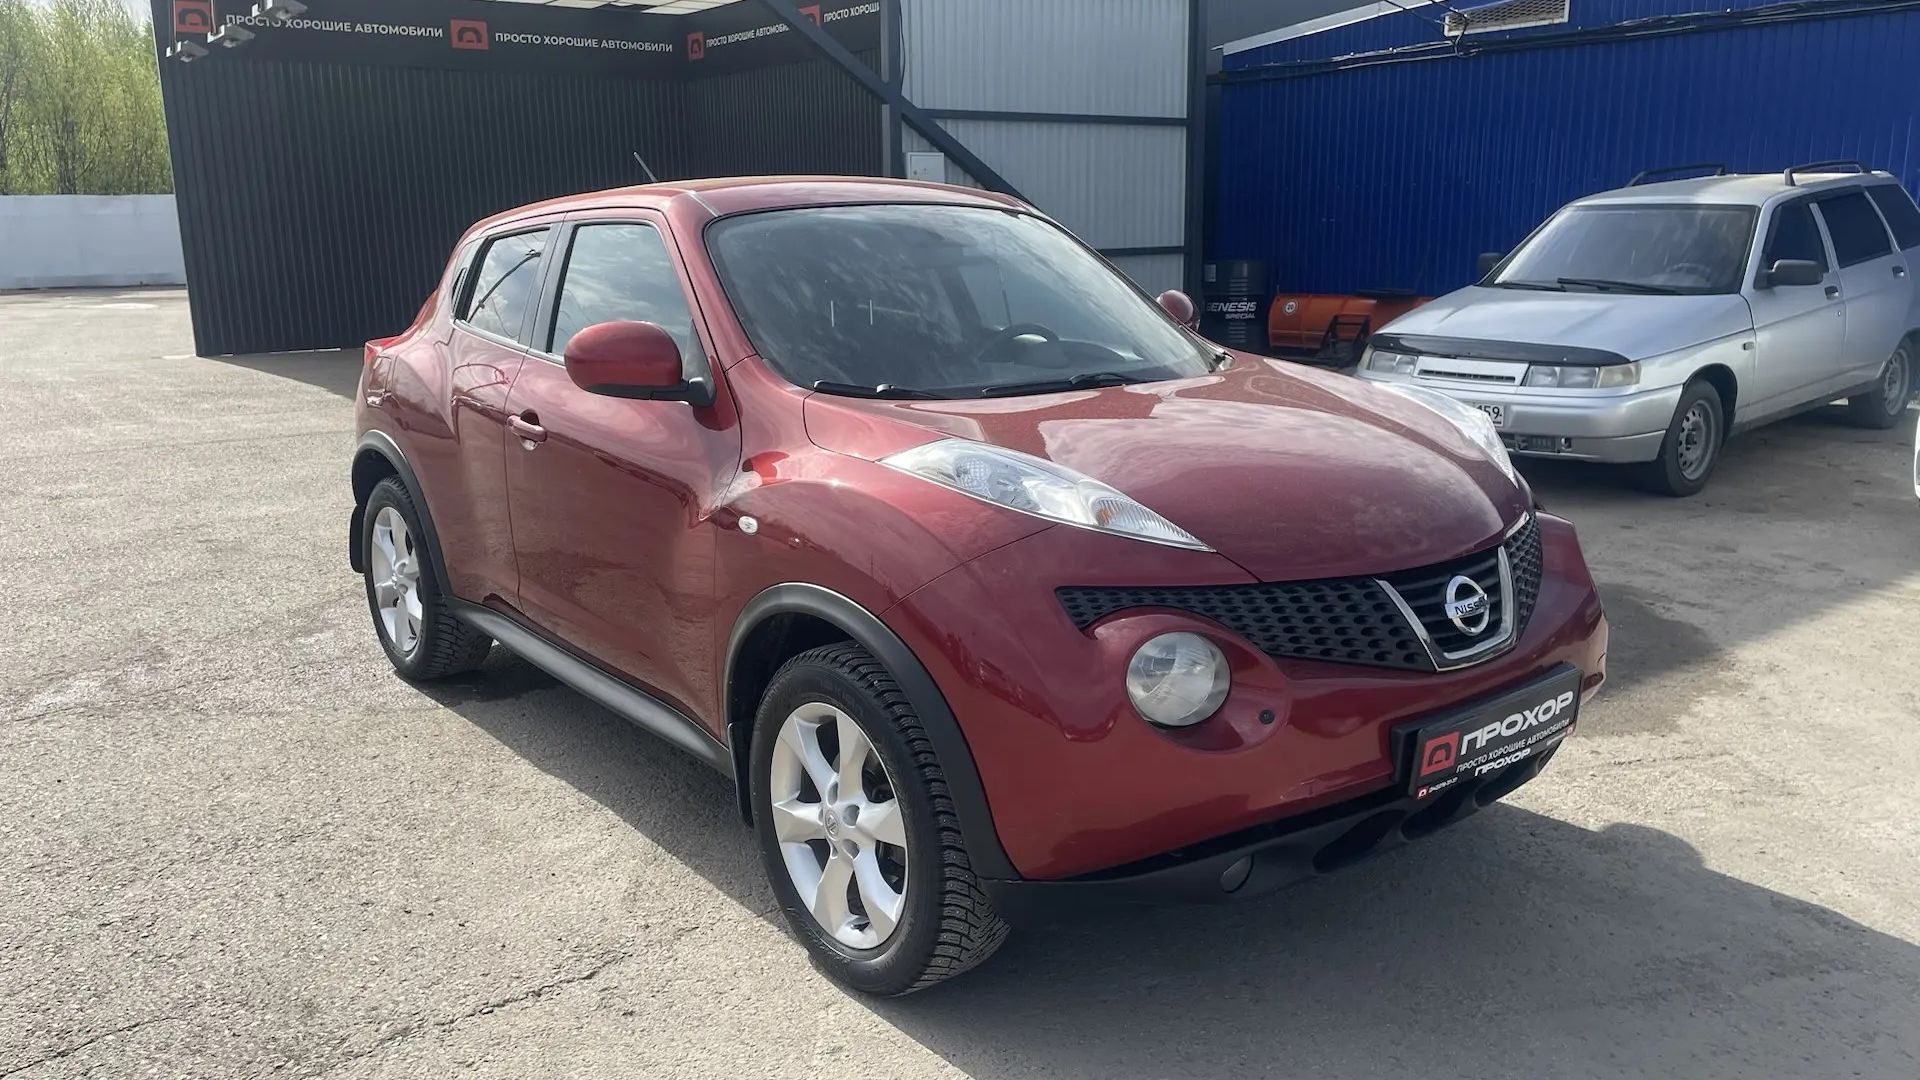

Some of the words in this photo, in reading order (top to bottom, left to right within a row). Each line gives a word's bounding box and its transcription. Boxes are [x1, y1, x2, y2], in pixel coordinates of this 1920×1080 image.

[226, 14, 281, 27] ПРОСТО
[285, 19, 352, 32] ХОРОШИЕ
[355, 23, 443, 37] АВТОМОБИЛИ
[823, 9, 849, 22] ПРОСТО
[495, 32, 541, 44] ПРОСТО
[543, 36, 598, 48] ХОРОШИЕ
[601, 40, 672, 52] АВТОМОБИЛИ
[706, 36, 727, 48] ПРОСТО
[1460, 691, 1574, 756] ПРОХОР
[1456, 754, 1488, 773] ПРОСТО
[1488, 738, 1526, 760] ХОРОШИЕ
[1526, 718, 1570, 746] АВТОМОБИЛИ
[1474, 747, 1532, 777] ПРОХОР
